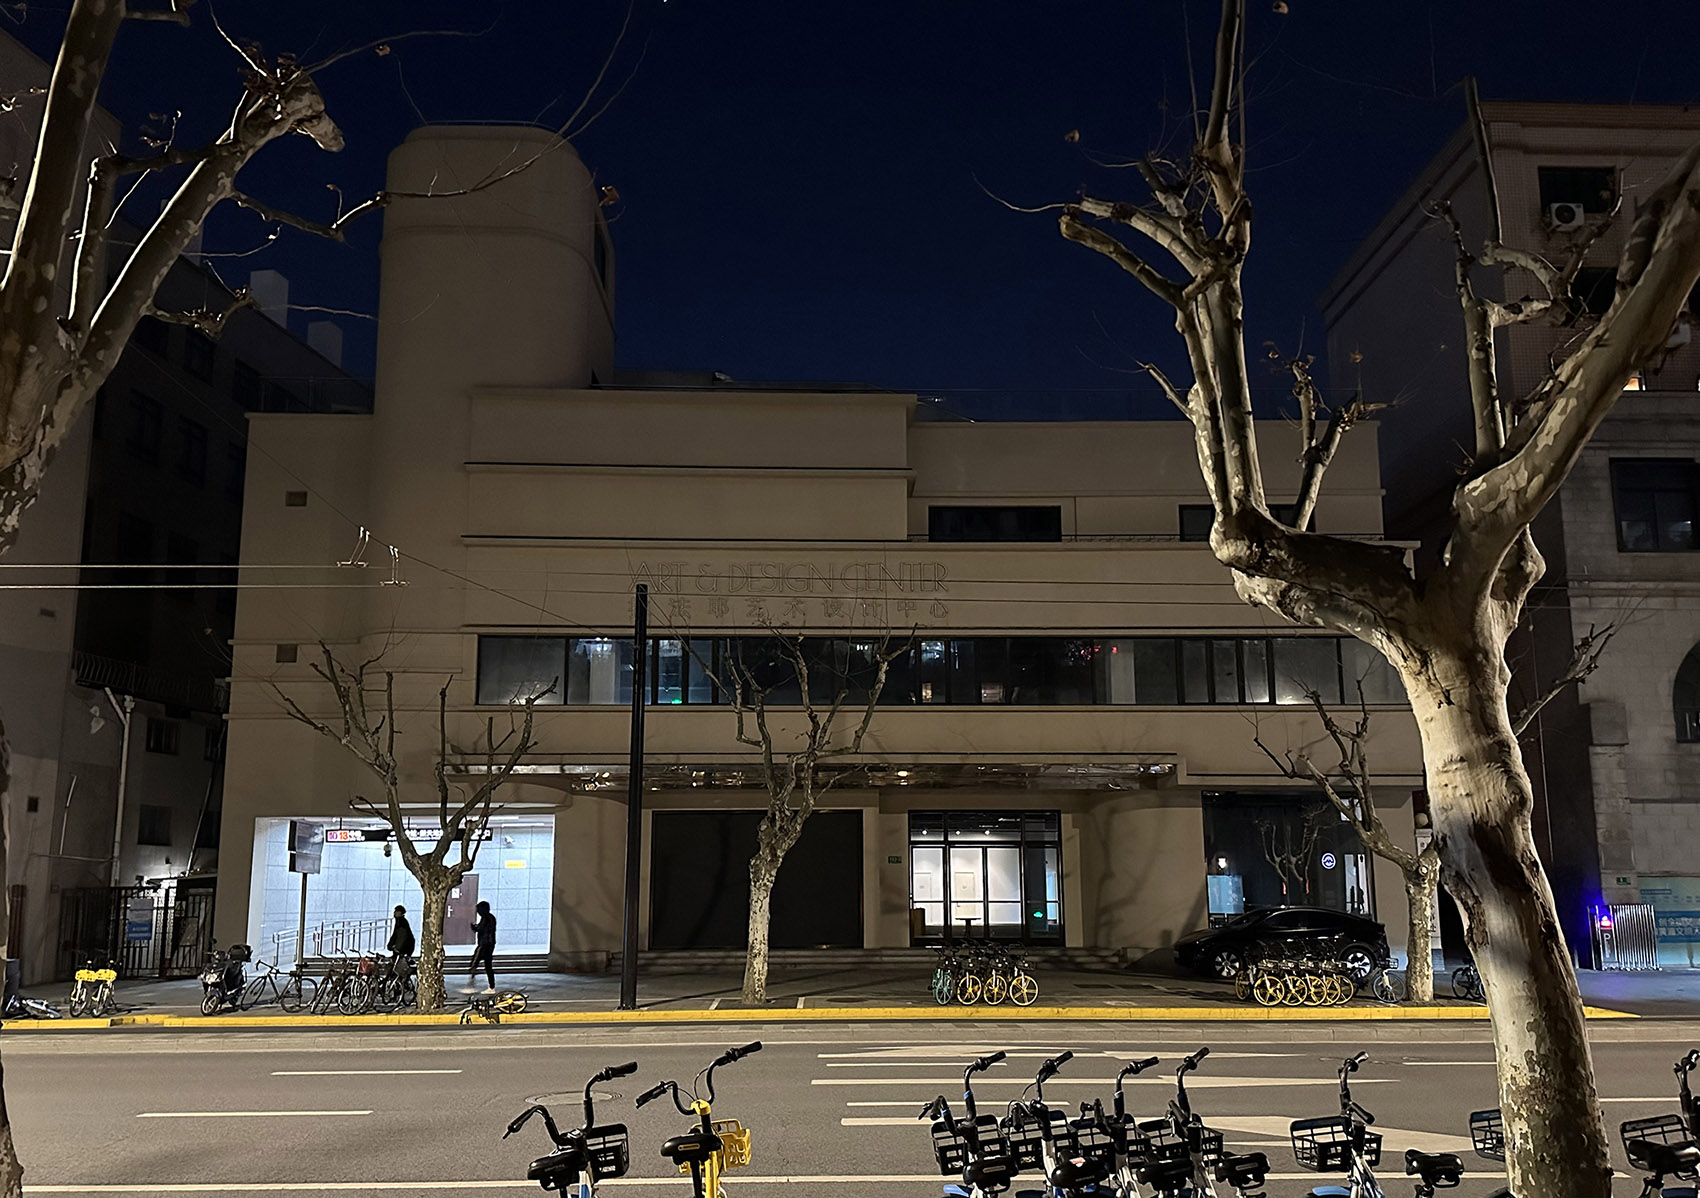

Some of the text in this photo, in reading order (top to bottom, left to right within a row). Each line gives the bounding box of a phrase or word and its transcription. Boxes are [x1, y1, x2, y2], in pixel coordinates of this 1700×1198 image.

[629, 562, 949, 593] ART & DESIGN CENTER
[328, 831, 338, 840] 10
[339, 831, 349, 840] 13
